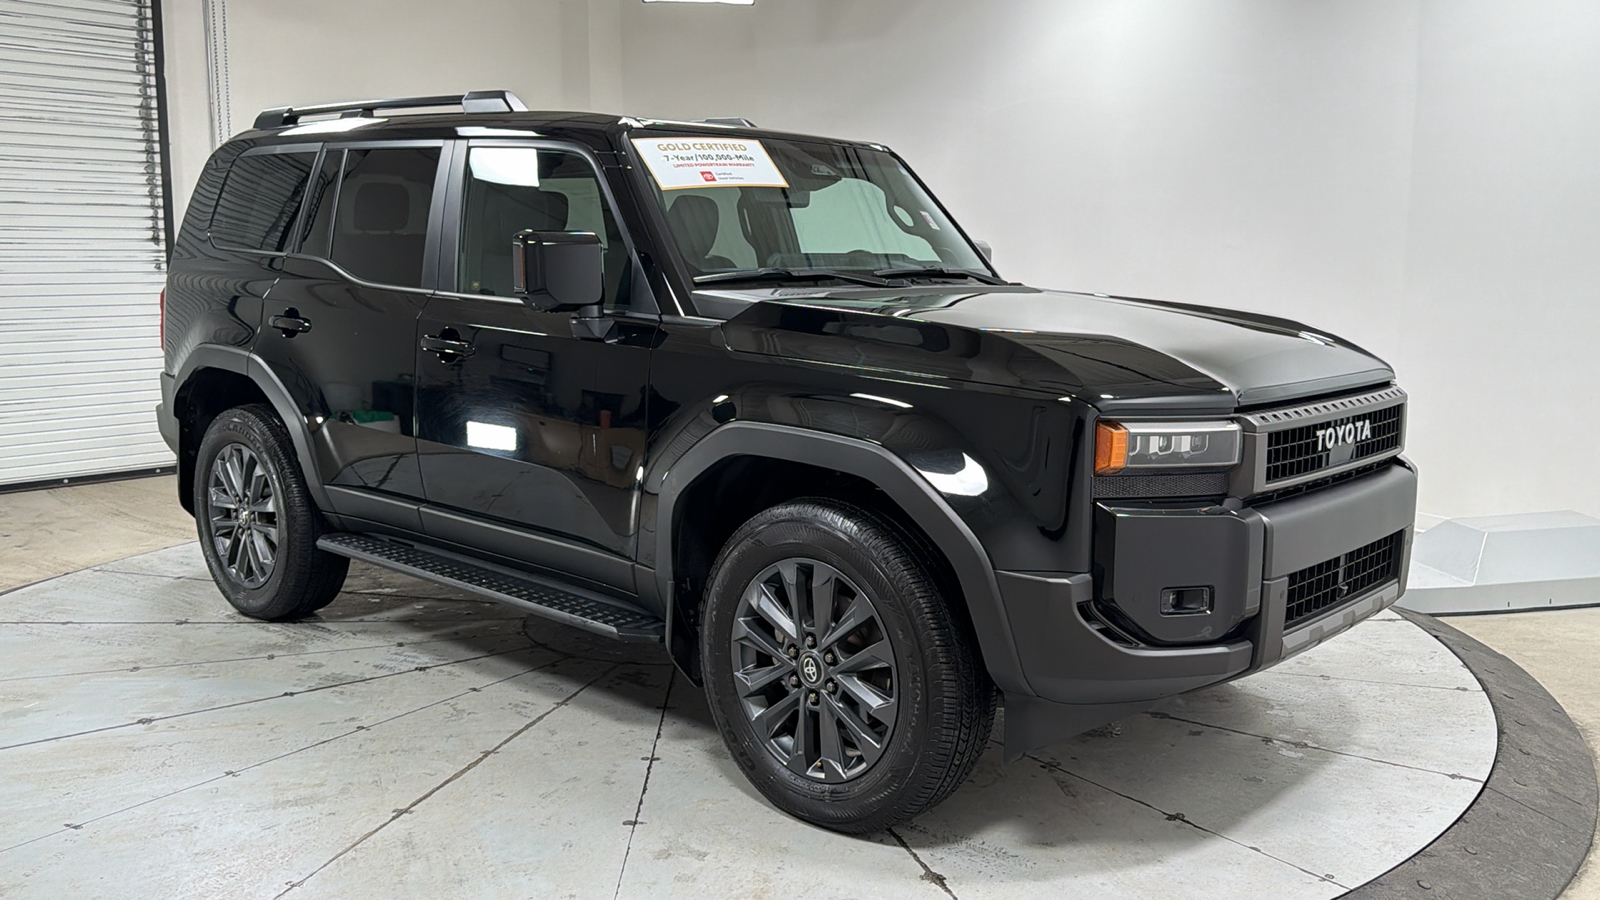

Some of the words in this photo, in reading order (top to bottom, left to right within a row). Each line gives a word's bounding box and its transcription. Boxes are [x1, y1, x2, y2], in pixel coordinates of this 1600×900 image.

[657, 143, 691, 152] GOLD
[692, 143, 747, 152] CERTIFIED
[663, 153, 754, 162] 7-Year/100,000-Mile
[1316, 420, 1371, 451] TOYOTA
